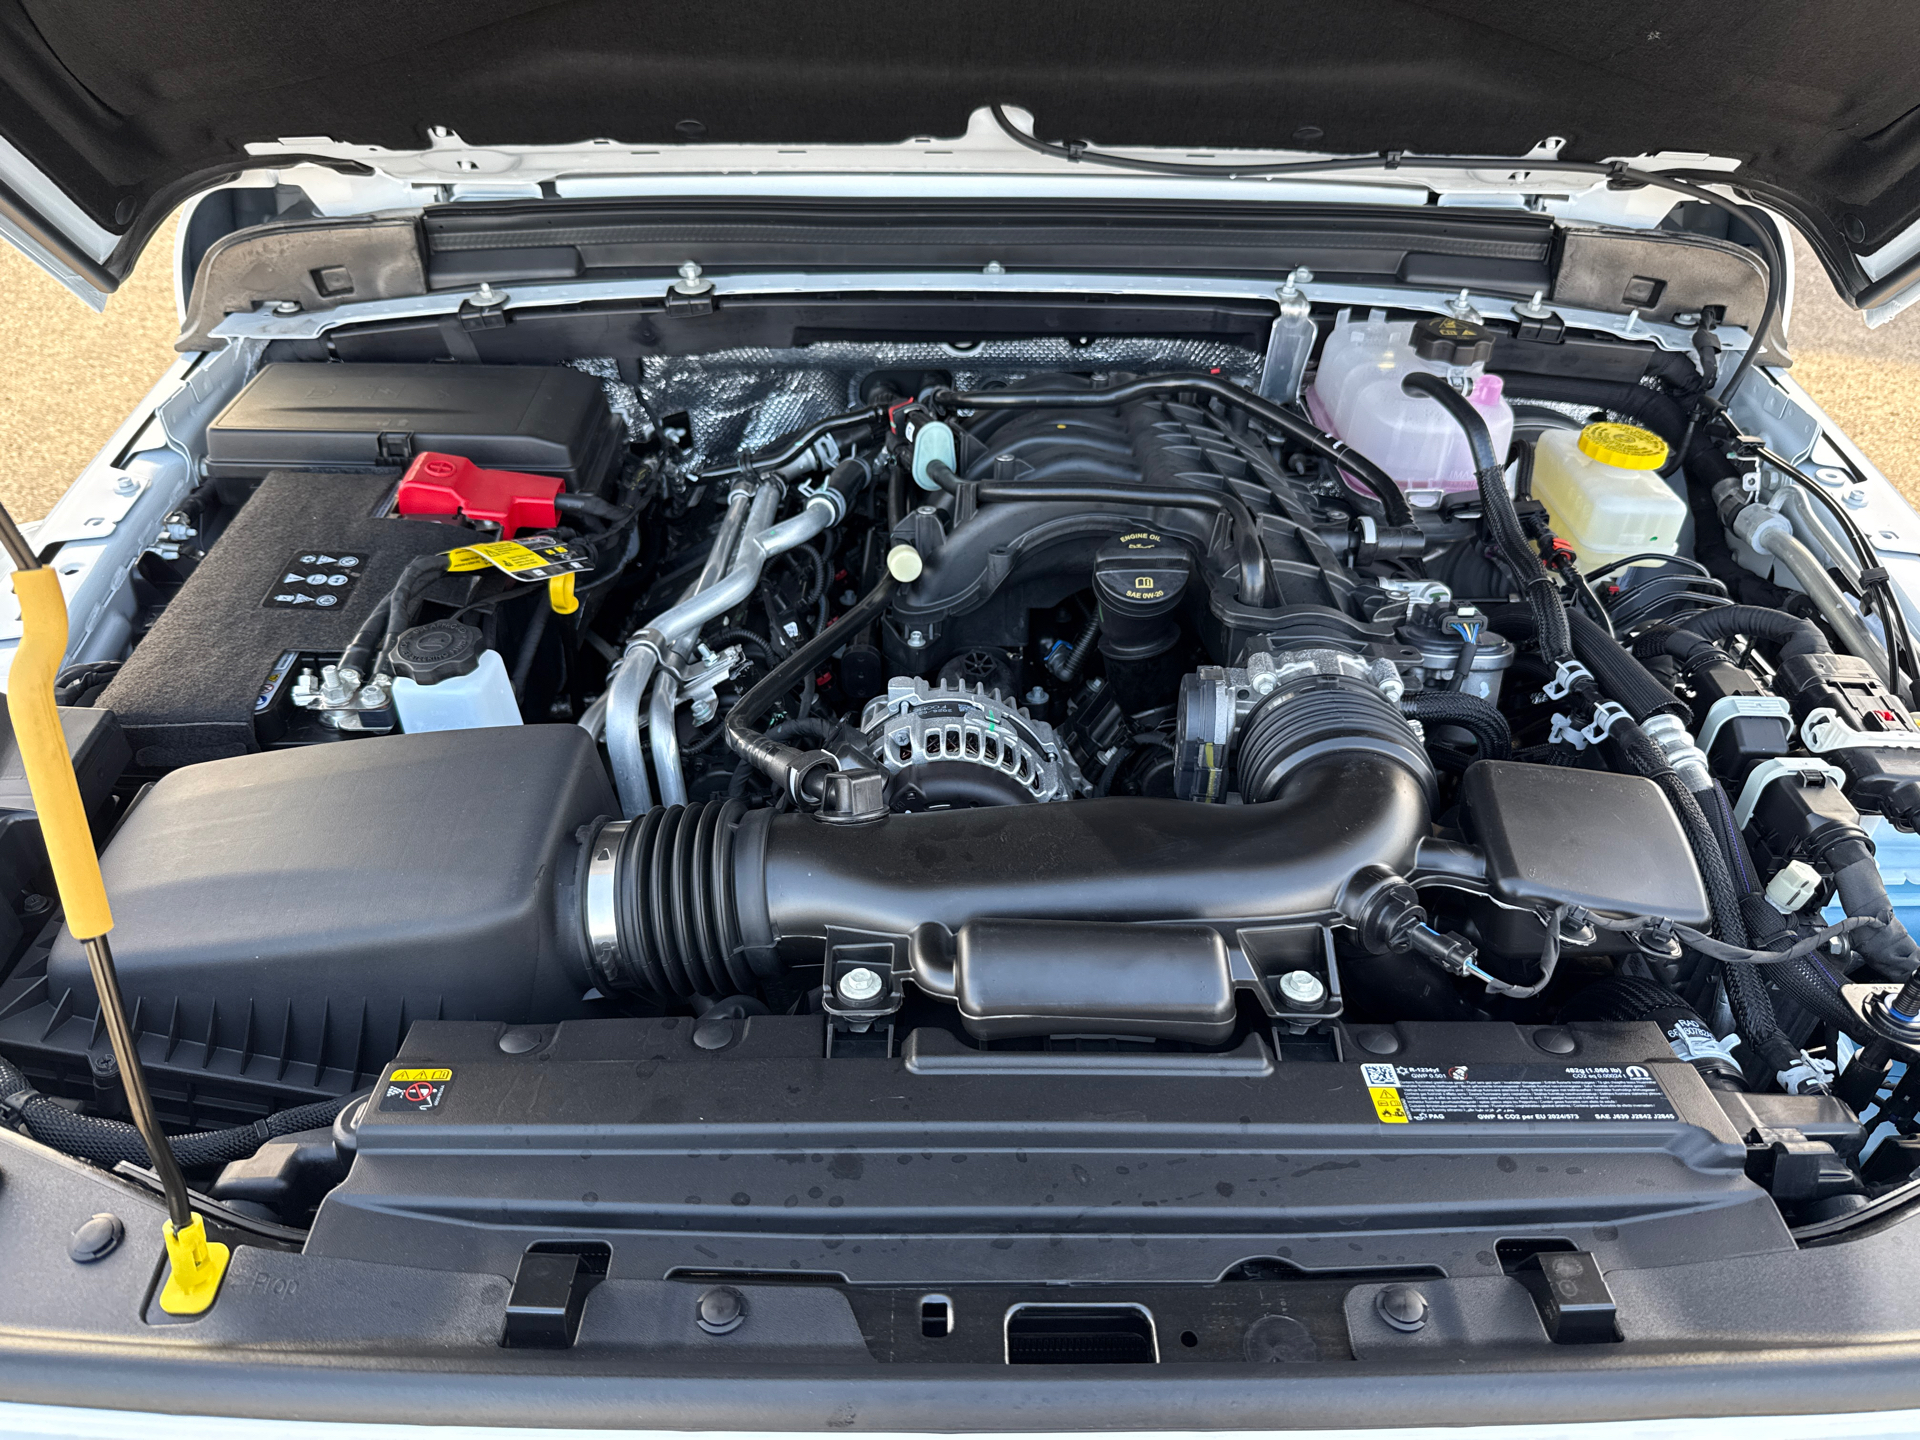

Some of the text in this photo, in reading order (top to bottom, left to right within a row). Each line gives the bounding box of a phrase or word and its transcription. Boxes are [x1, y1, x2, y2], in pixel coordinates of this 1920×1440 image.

[1120, 533, 1161, 543] ENGINE OIL
[1126, 590, 1164, 599] SAE 0W-20
[1678, 1019, 1700, 1028] RAD
